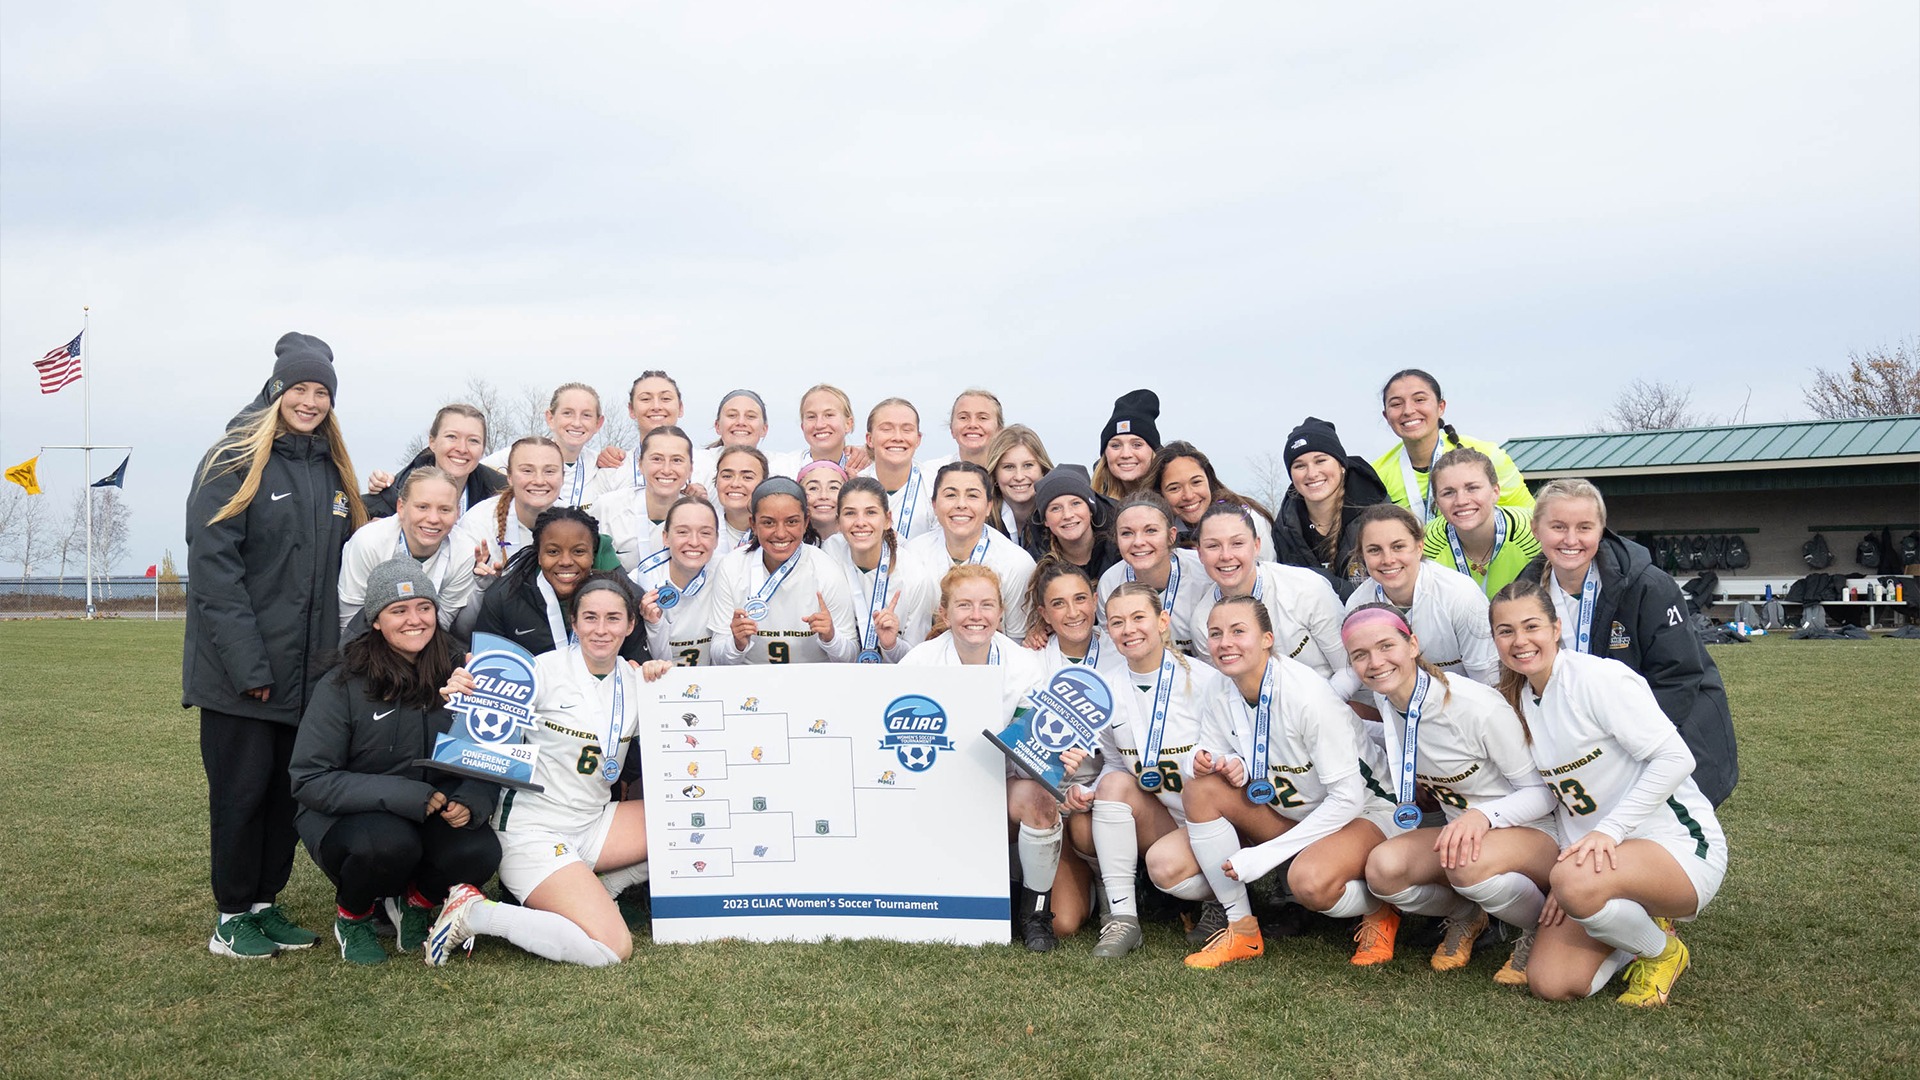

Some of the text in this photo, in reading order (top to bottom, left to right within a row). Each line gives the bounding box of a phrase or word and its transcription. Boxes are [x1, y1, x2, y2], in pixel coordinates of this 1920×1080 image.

[1667, 605, 1683, 626] 21
[677, 648, 700, 667] 3
[768, 641, 790, 664] 9
[473, 674, 531, 700] GLIAC
[463, 695, 526, 717] WOMEN'S SOCCER
[1053, 681, 1105, 724] GLIAC
[889, 716, 944, 731] GLIAC
[1040, 693, 1092, 739] WOMEN'S SOCCER
[544, 720, 599, 741] NORTHERN
[462, 749, 511, 767] CONFERENCE
[511, 748, 532, 760] 2023
[1015, 739, 1051, 772] TOURNAMENT
[1026, 736, 1051, 760] 2023
[462, 757, 507, 774] CHAMPIONS
[576, 745, 602, 775] 6
[1013, 747, 1045, 775] CHAMPIONS
[1552, 747, 1603, 776] MICHIGAN
[1430, 763, 1480, 783] MICHIGAN
[1270, 776, 1305, 808] 2
[723, 898, 939, 910] 2023 GLIAC Women's Soccer Tournament
